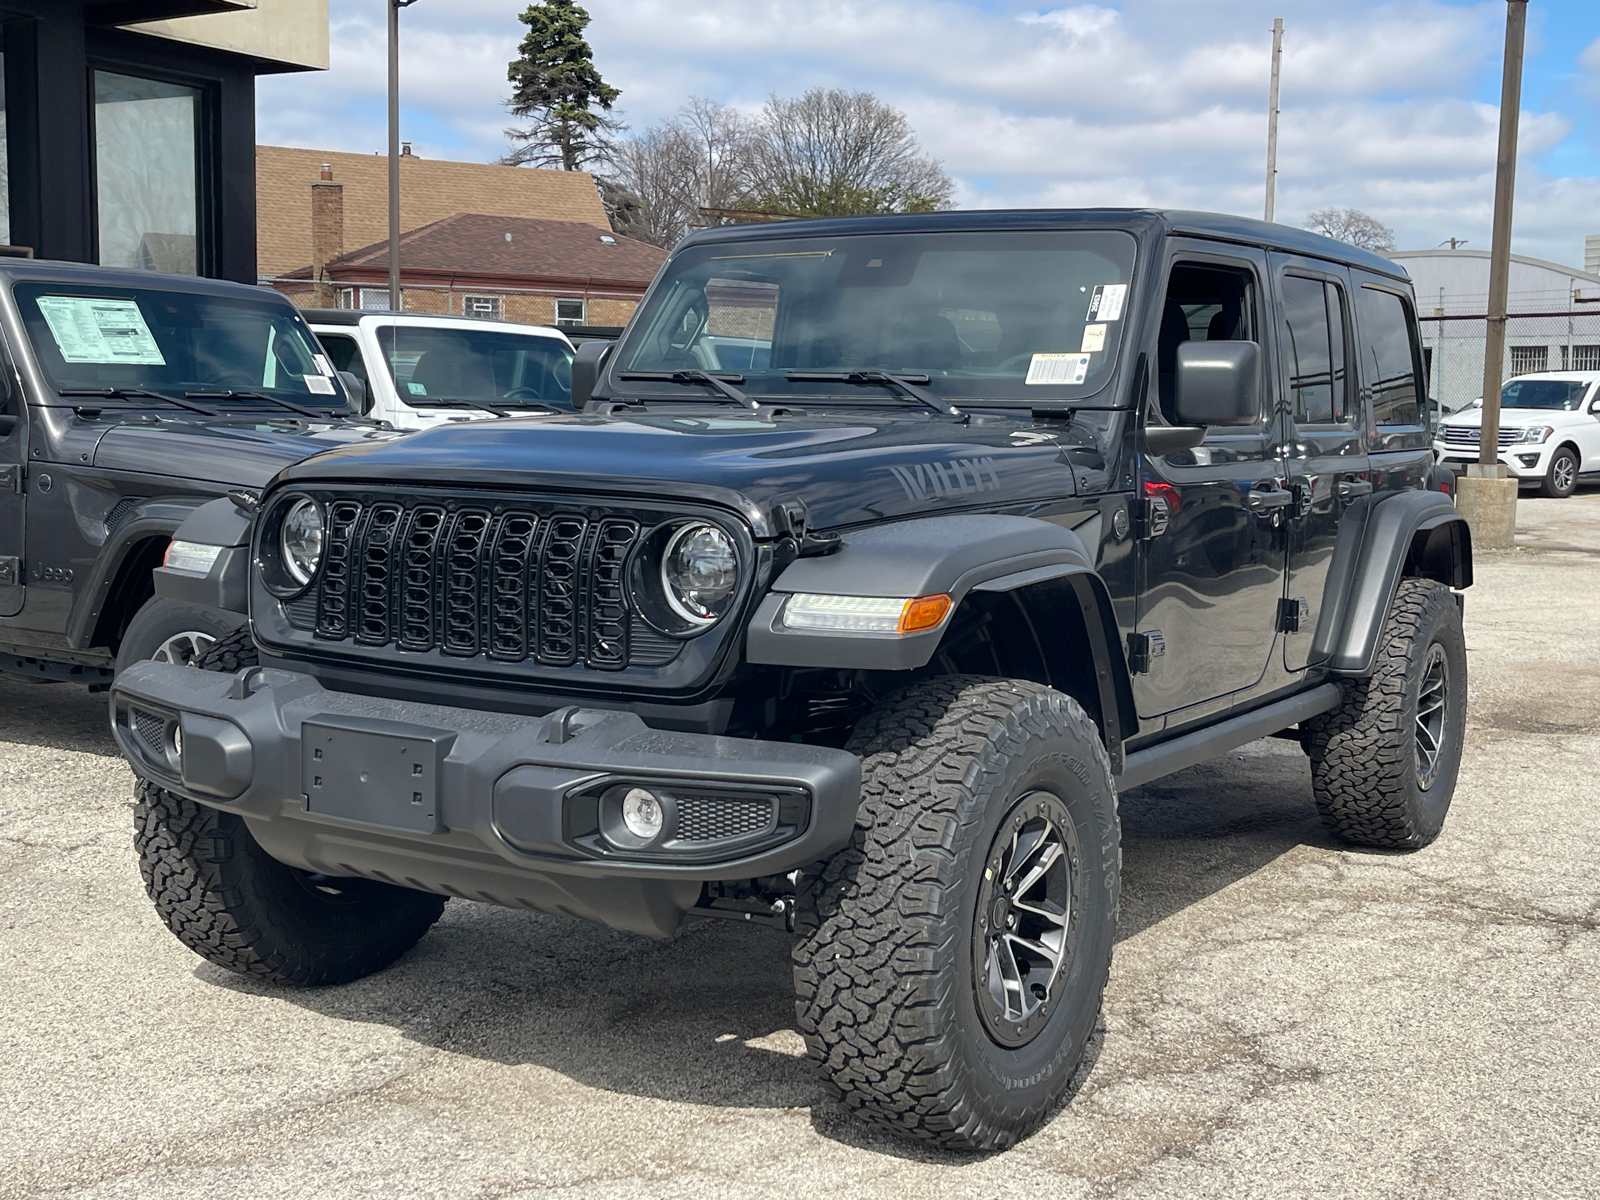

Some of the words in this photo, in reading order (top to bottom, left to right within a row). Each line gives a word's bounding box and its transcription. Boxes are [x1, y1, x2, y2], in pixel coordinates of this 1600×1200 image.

[889, 457, 1001, 501] WILLYS
[31, 561, 75, 586] Jeep
[976, 1031, 1073, 1091] BFGoodrich
